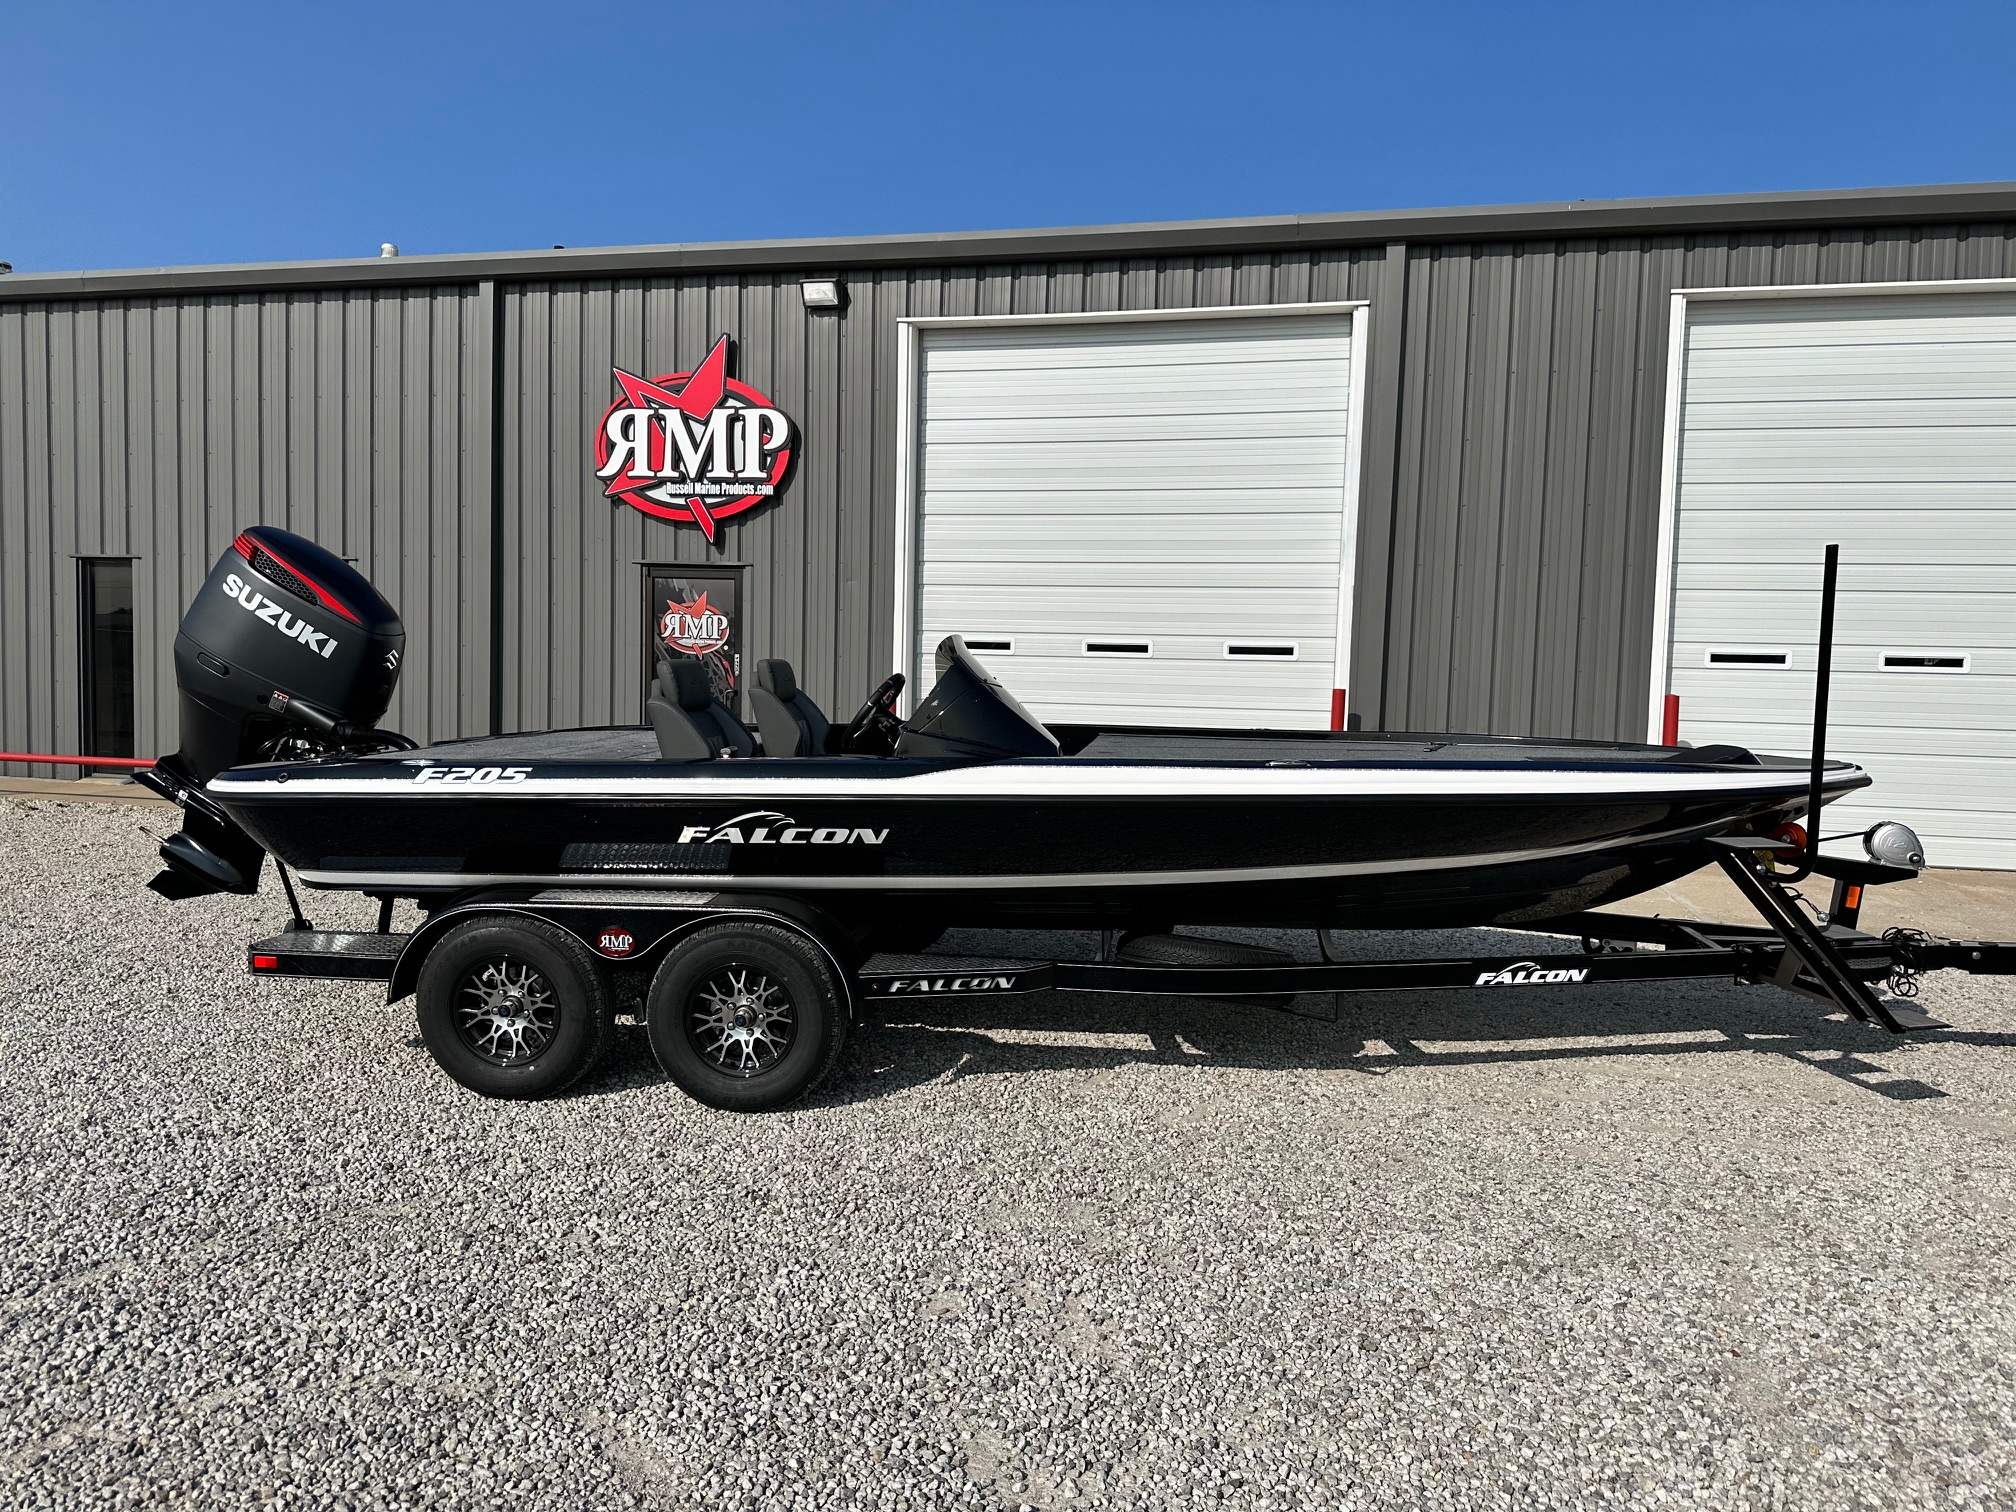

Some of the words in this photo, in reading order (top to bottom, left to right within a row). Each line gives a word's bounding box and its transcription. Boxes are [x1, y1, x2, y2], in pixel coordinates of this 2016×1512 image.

[666, 482, 694, 495] Russell
[695, 482, 720, 495] Marine
[222, 573, 339, 660] SUZUKI
[412, 767, 533, 785] F205
[677, 825, 890, 844] FALCON
[888, 976, 1017, 993] FALCON
[1475, 967, 1589, 986] FALCON
